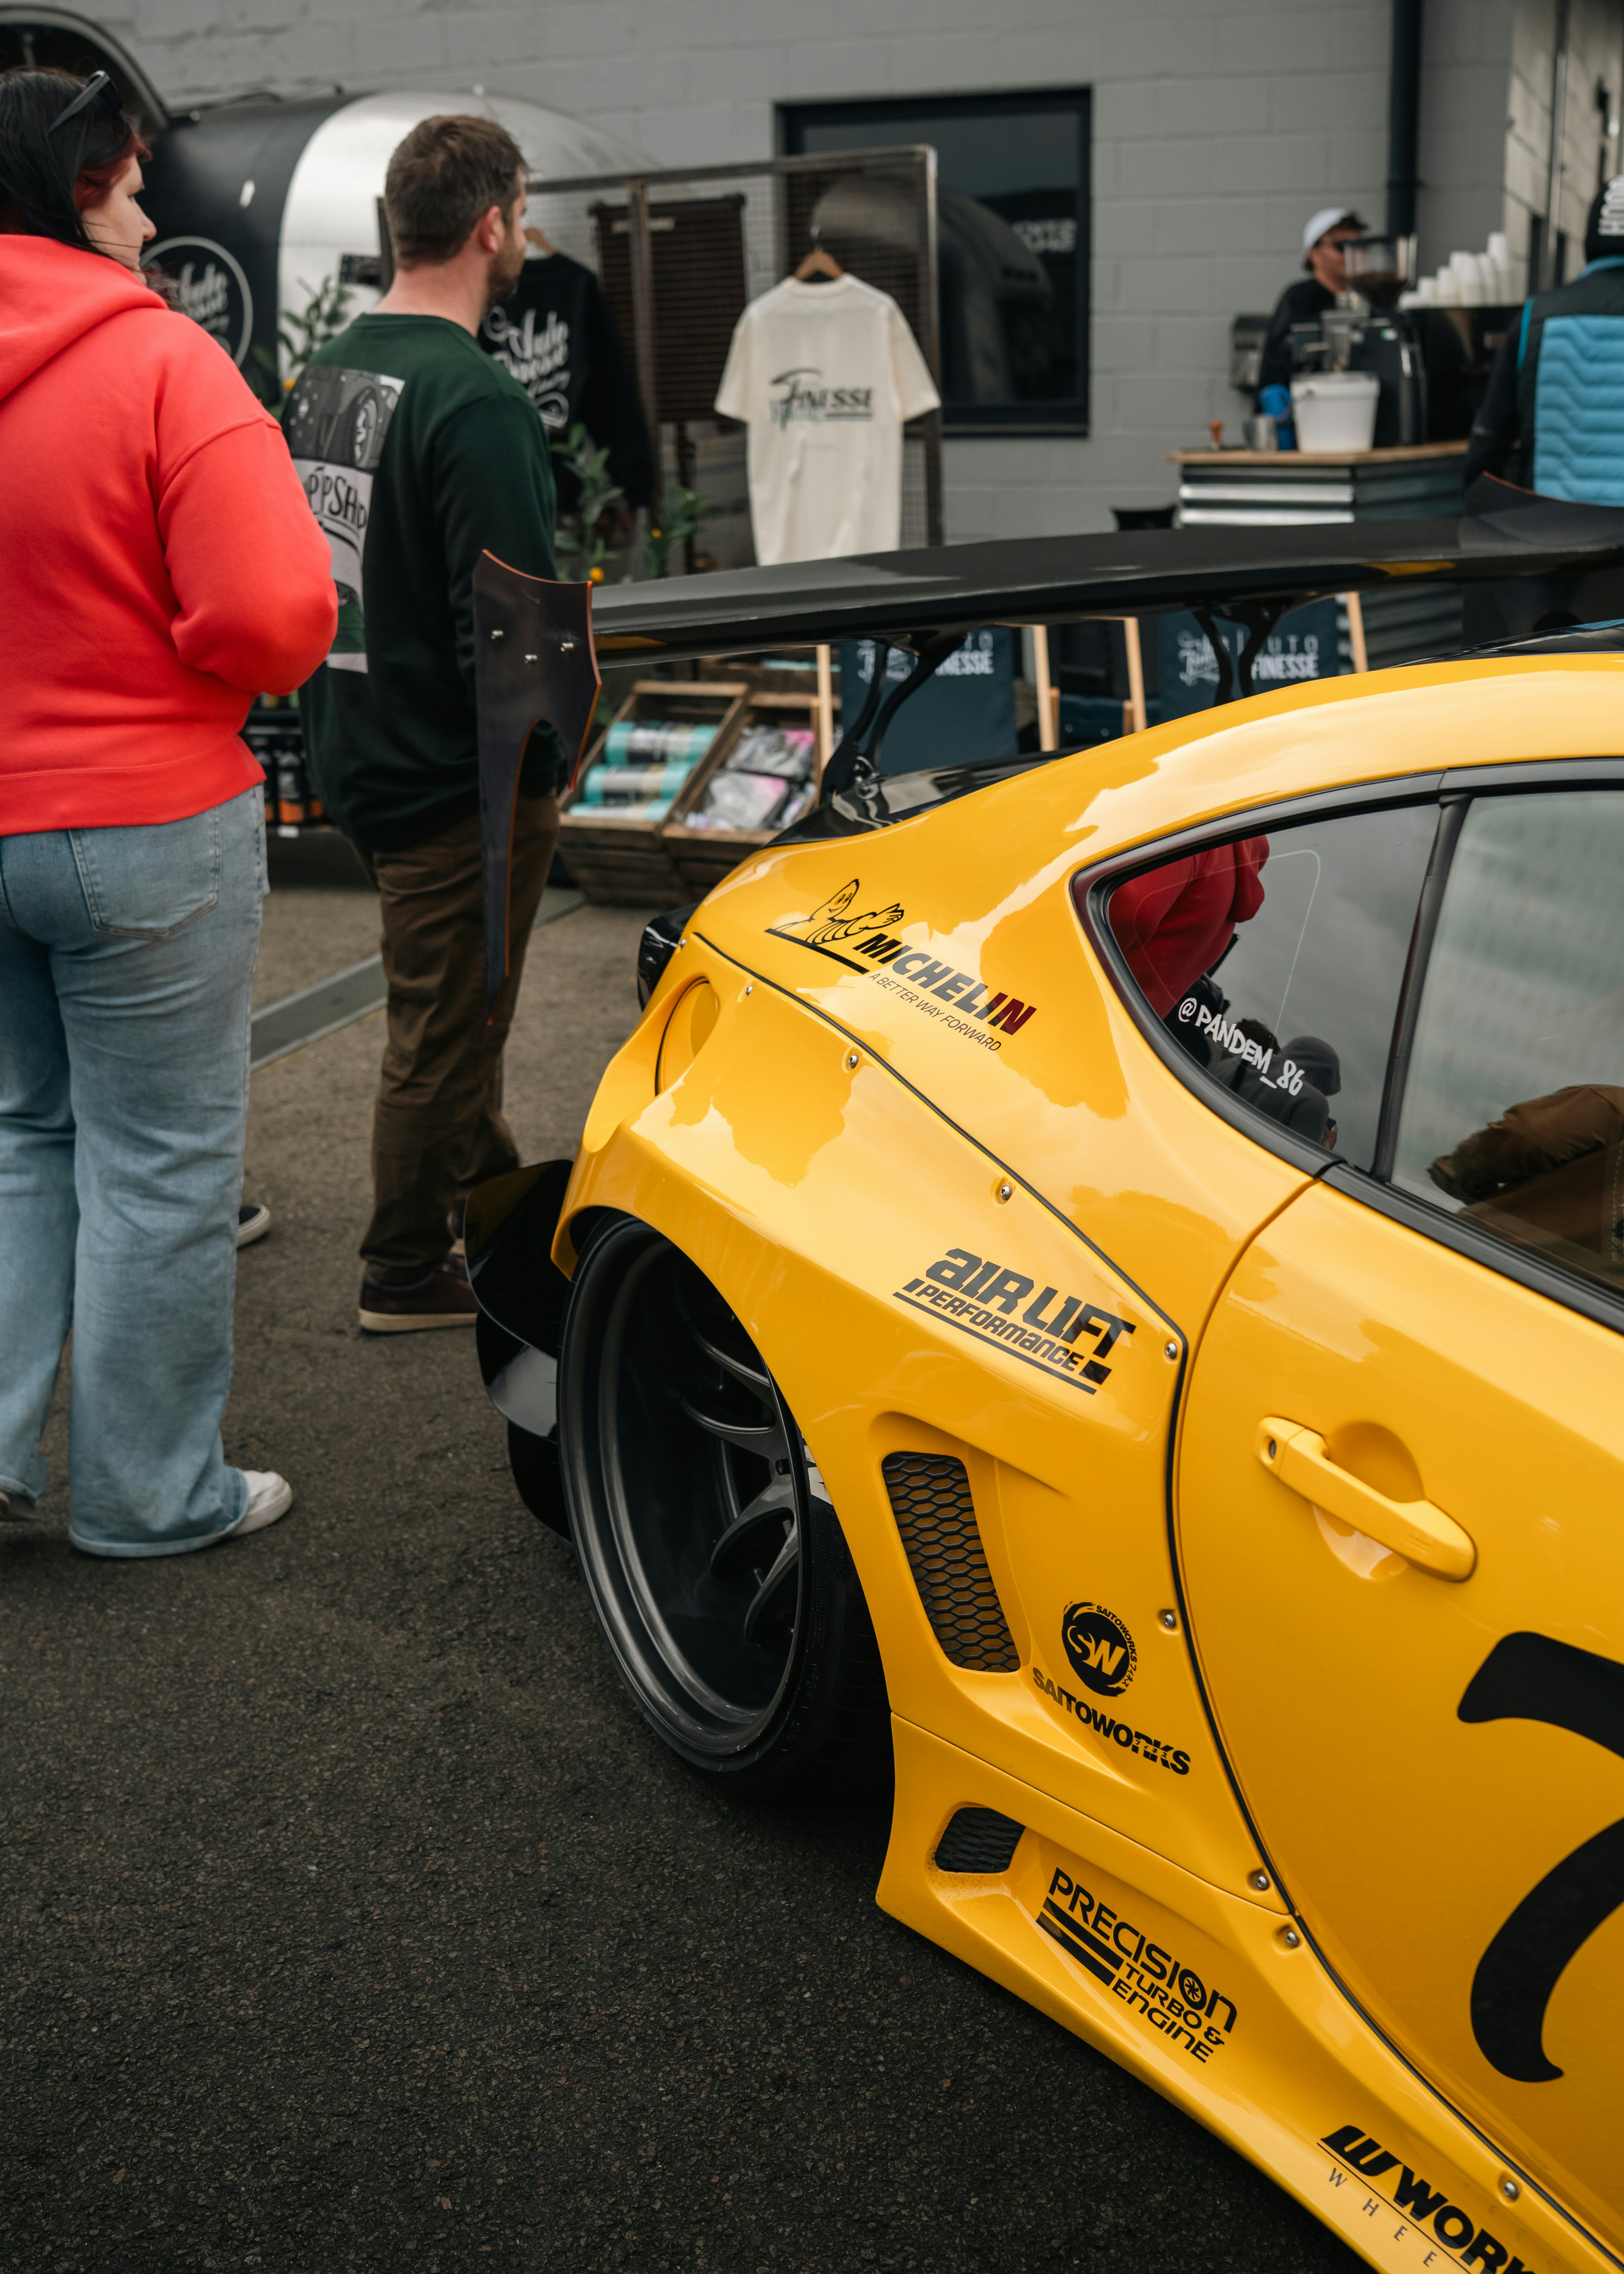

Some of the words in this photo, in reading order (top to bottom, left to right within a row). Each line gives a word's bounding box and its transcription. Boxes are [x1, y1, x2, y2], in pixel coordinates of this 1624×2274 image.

[852, 933, 1037, 1035] MICHELIN
[876, 977, 919, 1003] BETTER
[916, 1000, 945, 1018] WAY
[940, 1015, 1002, 1051] FORWARD
[1178, 997, 1305, 1096] @PANDEM_86
[1096, 1605, 1138, 1663] SAITOWORKS
[1033, 1667, 1191, 1775] SAITOWORKS
[1126, 1962, 1203, 2030] TURBO
[1203, 2026, 1225, 2045] &
